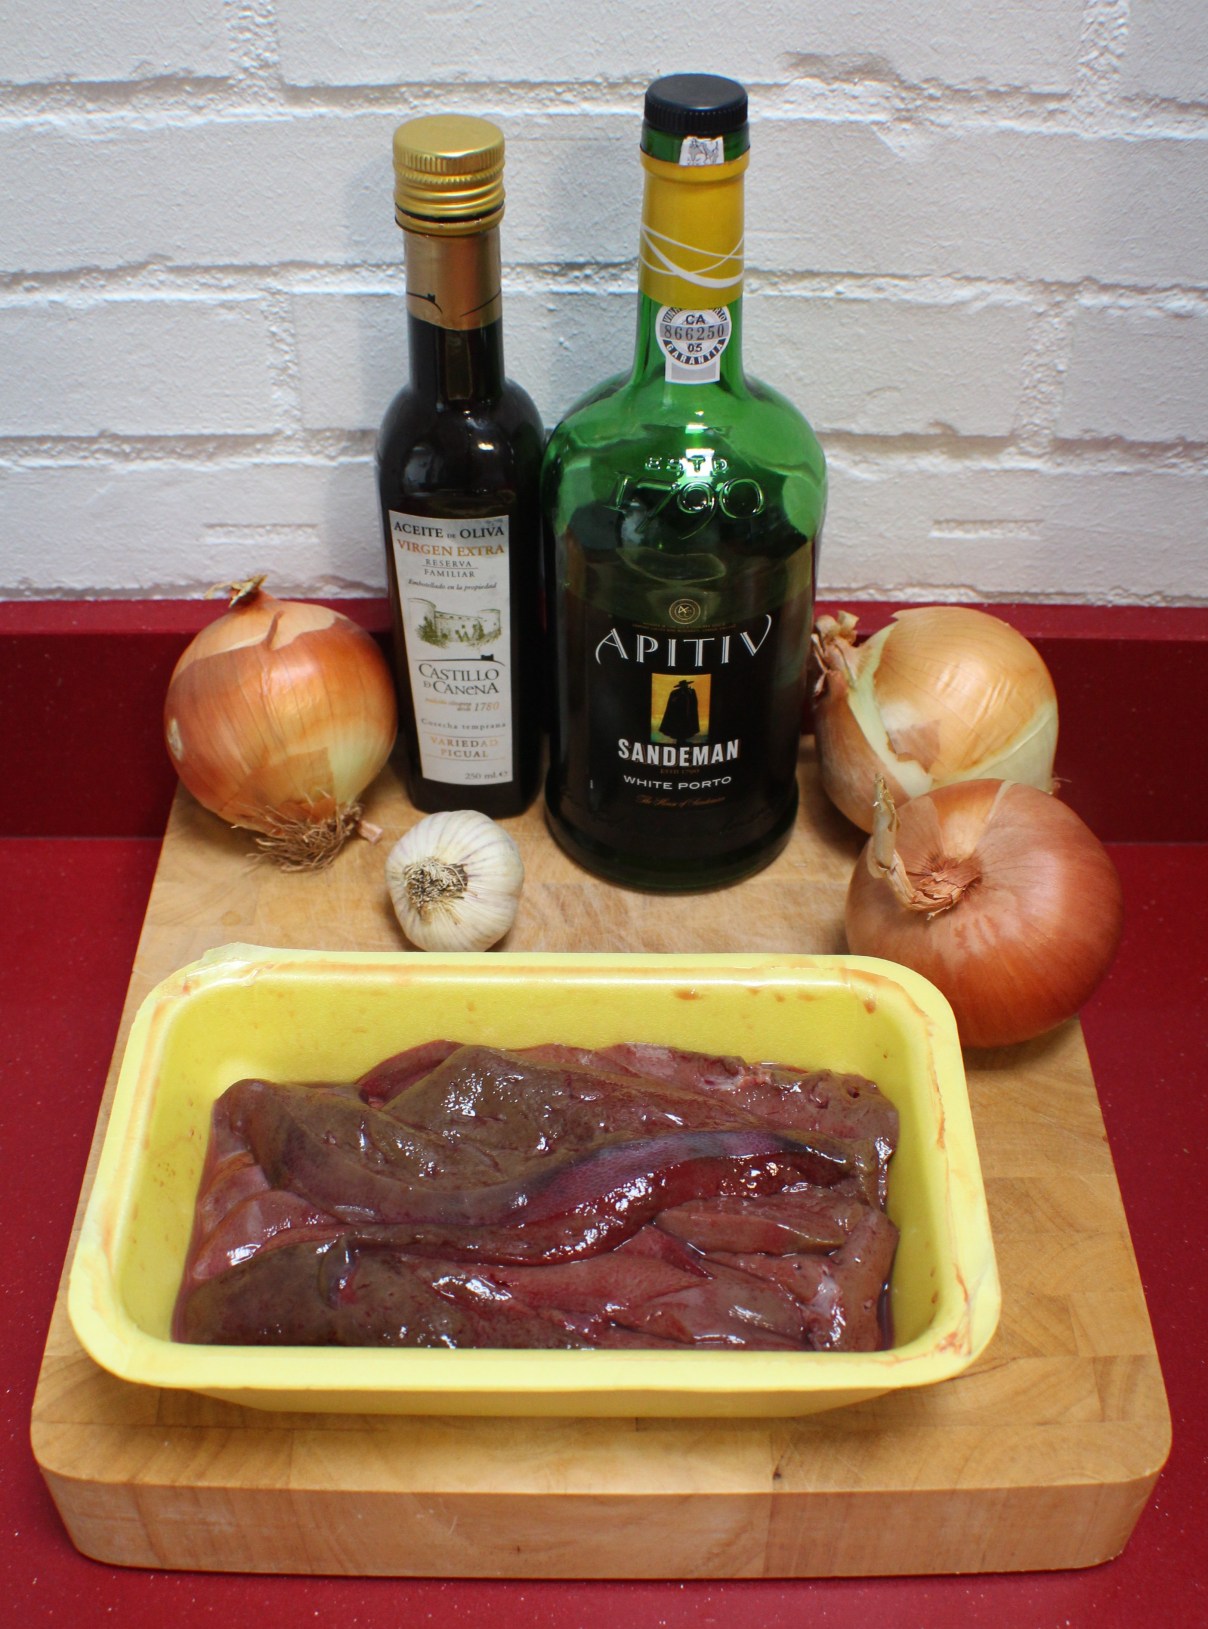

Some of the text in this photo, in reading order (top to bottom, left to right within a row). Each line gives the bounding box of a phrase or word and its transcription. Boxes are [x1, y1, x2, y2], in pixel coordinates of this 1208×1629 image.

[685, 314, 706, 325] CA
[664, 324, 725, 341] 866250
[666, 342, 725, 365] GARANTIA
[394, 521, 444, 539] ACEITE
[459, 526, 505, 540] OLIVA
[397, 538, 505, 557] VIRGEN EXTRA
[425, 558, 473, 568] RESERVA
[424, 568, 476, 578] FAMILIAR
[595, 614, 773, 667] APITIV
[418, 663, 500, 682] CASTILLO
[421, 718, 507, 733] Cosecha temprana
[431, 736, 499, 748] VARIEDAD
[441, 748, 489, 759] PICUAL
[617, 738, 741, 768] SANDEMAN
[622, 775, 733, 791] WHITE PORTO
